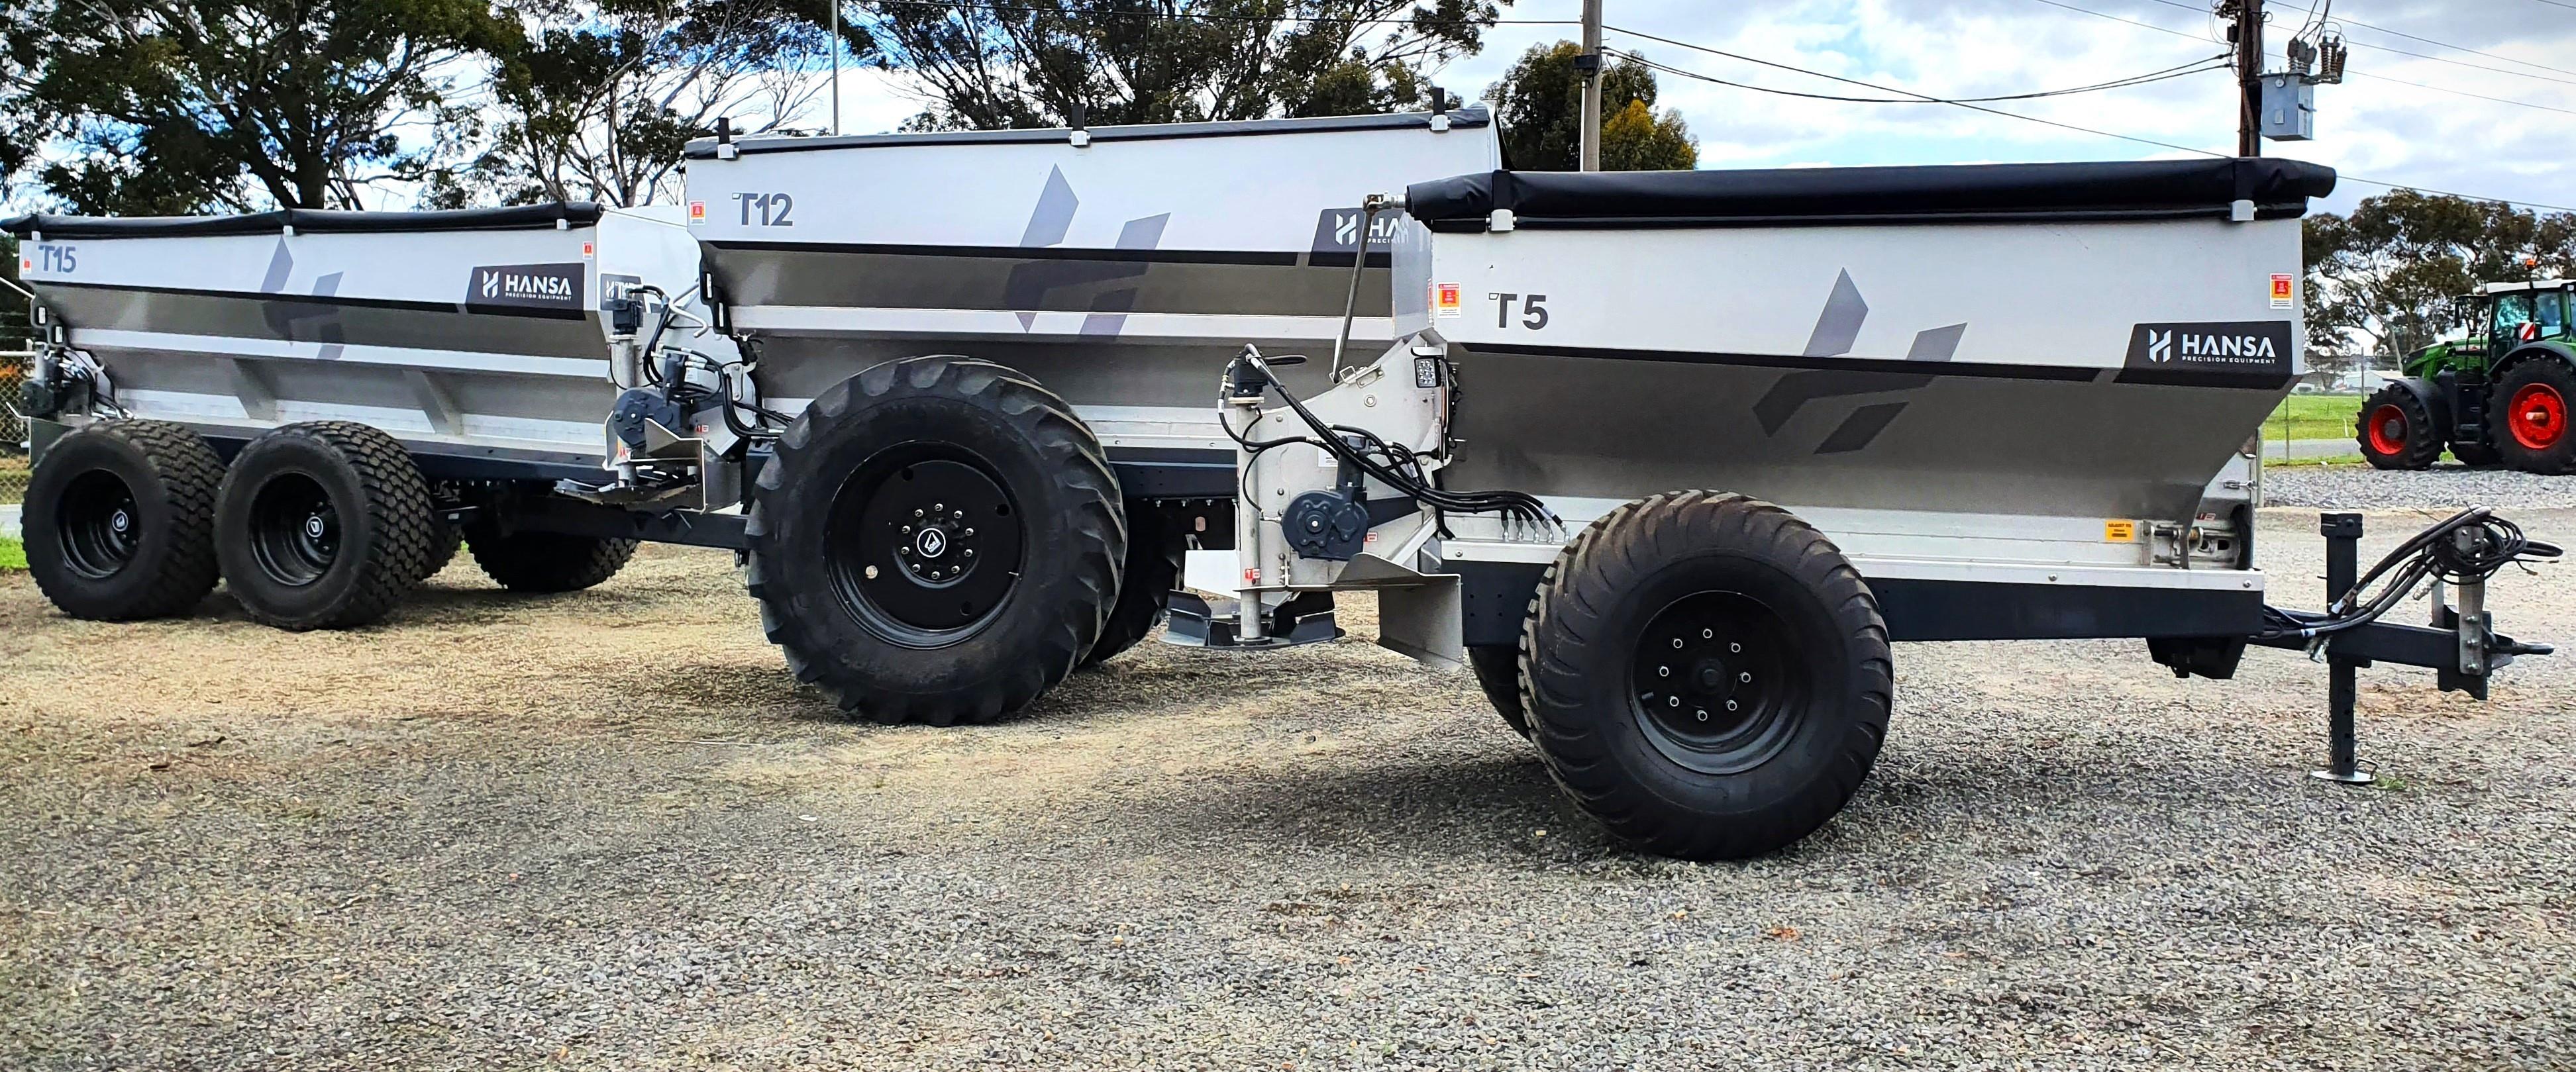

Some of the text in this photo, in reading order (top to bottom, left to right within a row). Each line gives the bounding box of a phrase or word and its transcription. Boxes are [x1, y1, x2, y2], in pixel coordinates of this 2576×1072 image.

[732, 193, 793, 226] T12
[38, 245, 76, 273] T15
[505, 274, 572, 295] HANSA
[1488, 293, 1549, 330] T5
[2182, 334, 2276, 358] HANSA
